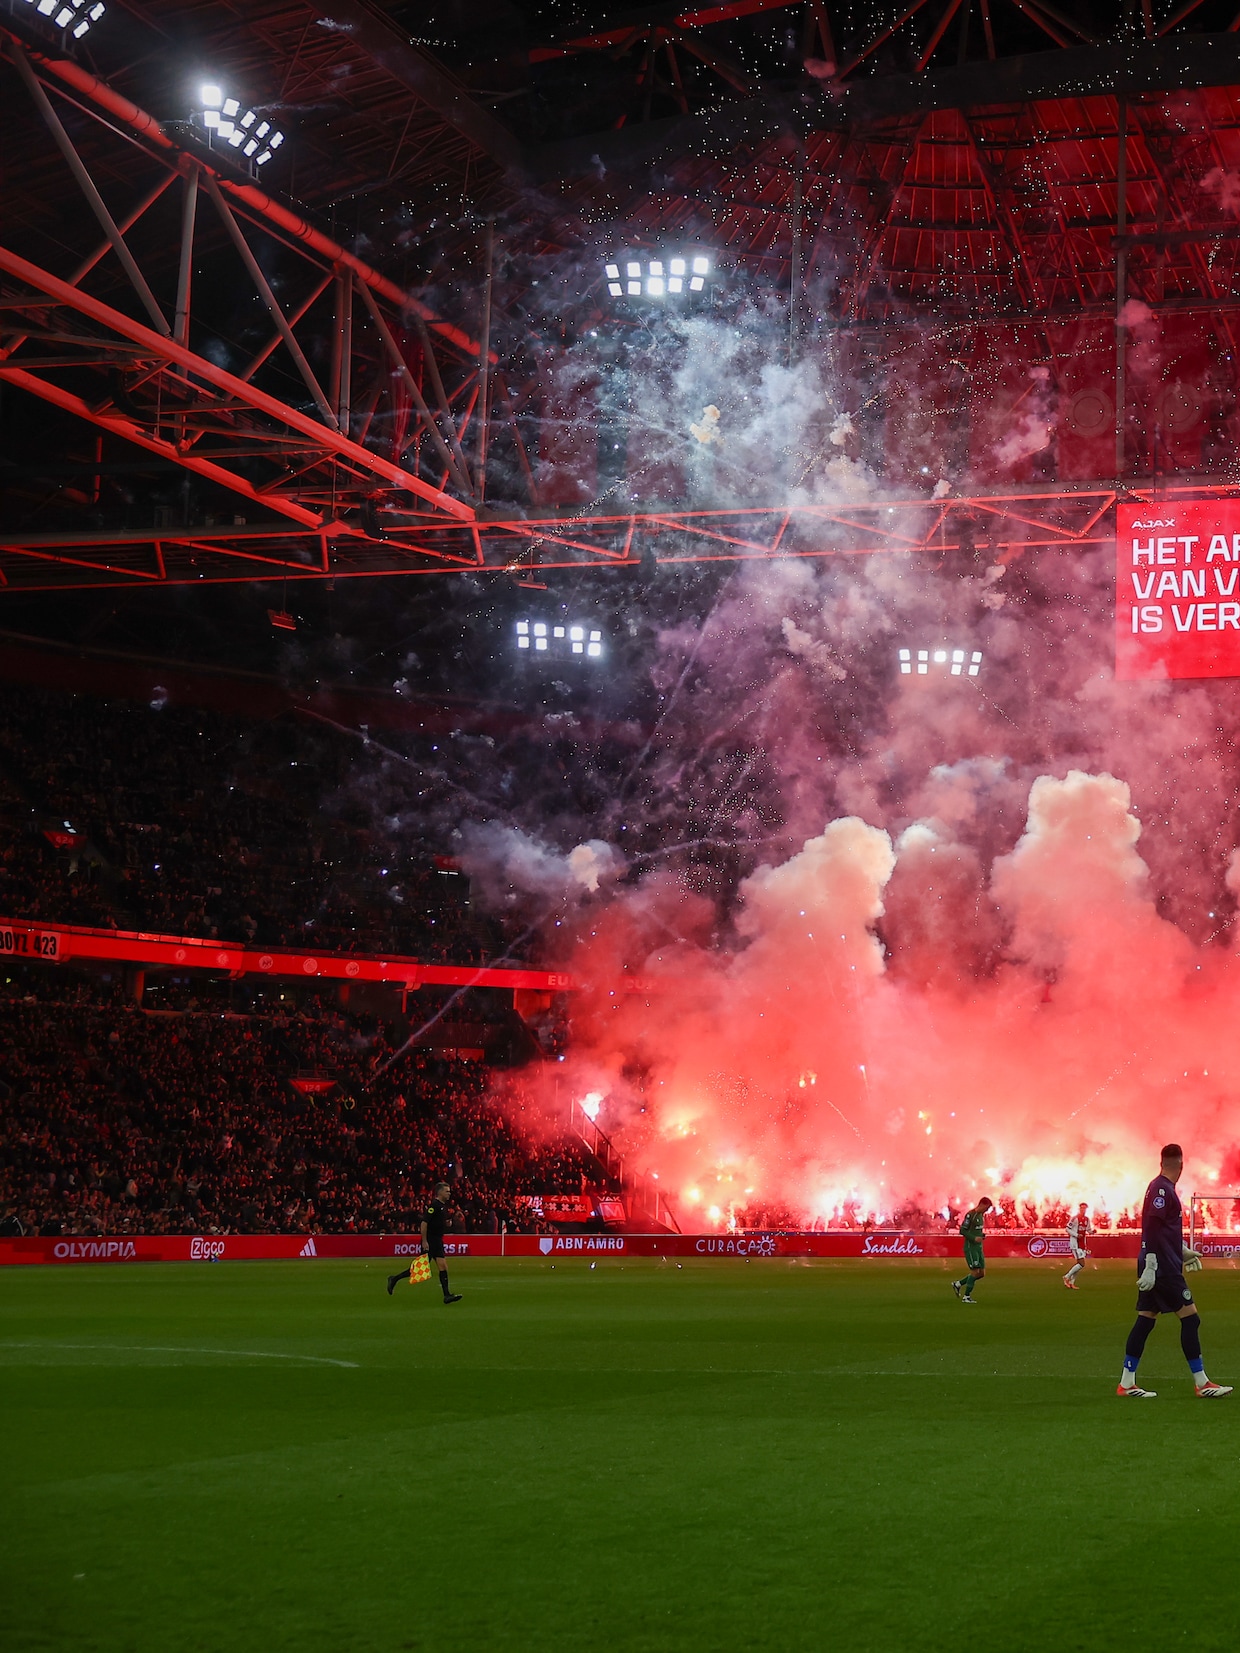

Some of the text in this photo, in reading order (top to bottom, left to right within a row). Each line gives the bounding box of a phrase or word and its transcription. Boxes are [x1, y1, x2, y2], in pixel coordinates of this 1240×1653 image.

[1131, 518, 1176, 530] AJAX
[1132, 535, 1199, 566] HET
[1131, 569, 1206, 600] VAN
[1131, 605, 1164, 634] IS
[34, 935, 57, 956] 423
[304, 1084, 321, 1093] 124
[54, 1242, 136, 1259] OLYMPIA
[458, 1243, 468, 1254] IT
